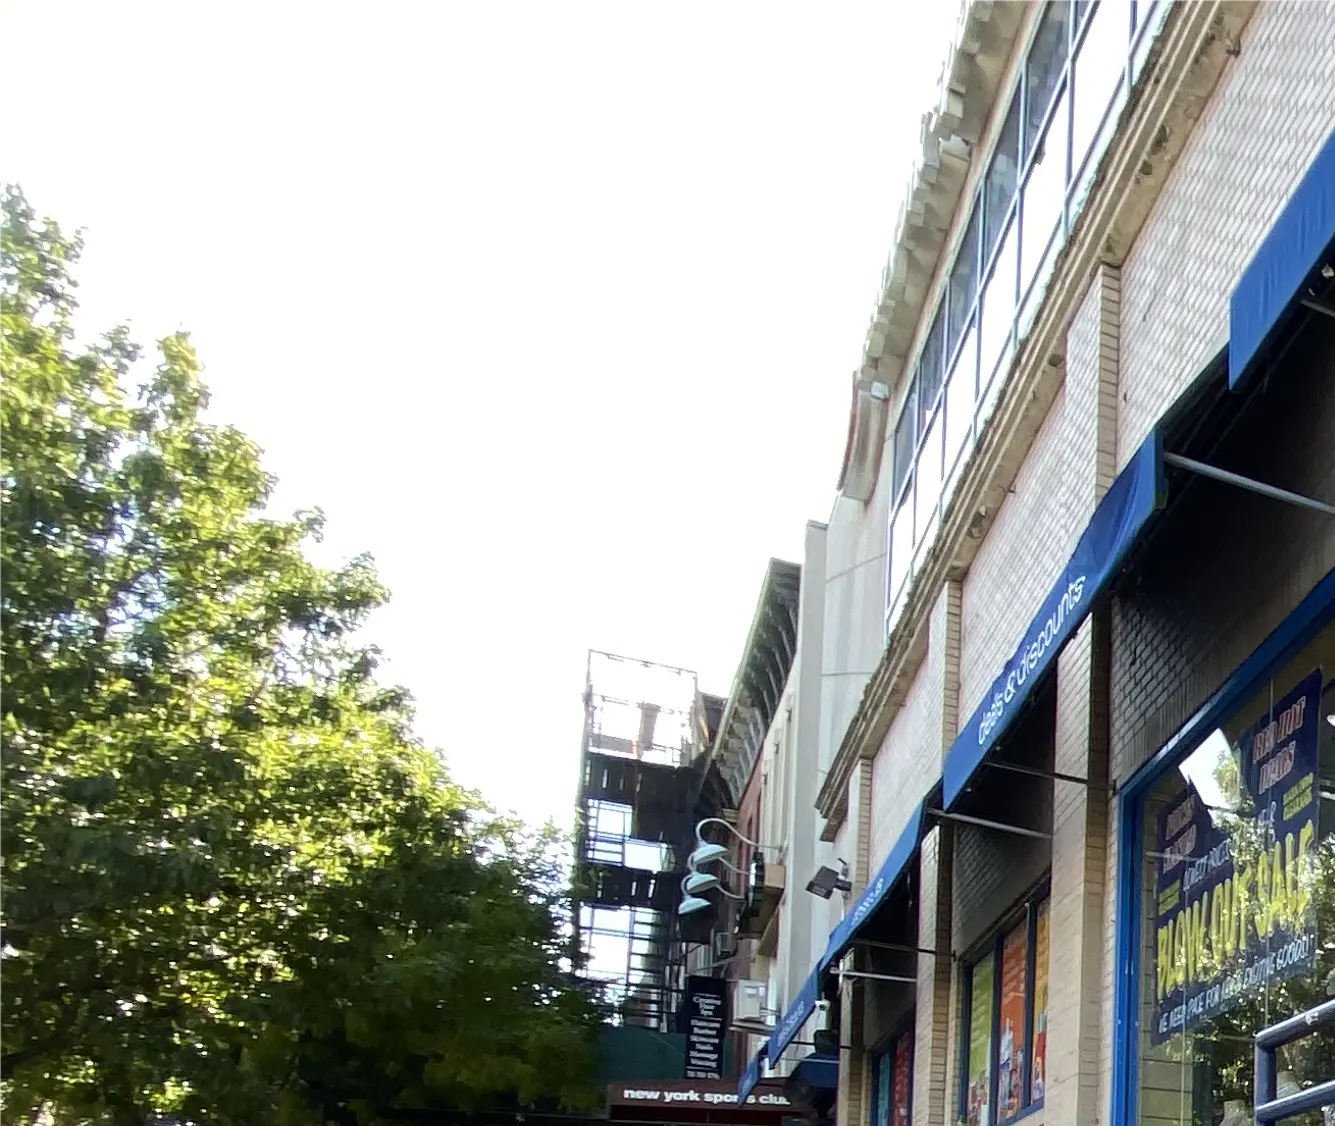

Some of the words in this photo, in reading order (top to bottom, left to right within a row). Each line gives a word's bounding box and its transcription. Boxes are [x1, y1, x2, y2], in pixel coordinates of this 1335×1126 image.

[1016, 575, 1086, 686] discounts
[623, 1088, 660, 1100] new
[663, 1089, 700, 1103] york
[703, 1092, 756, 1105] spors
[759, 1092, 791, 1106] clu
